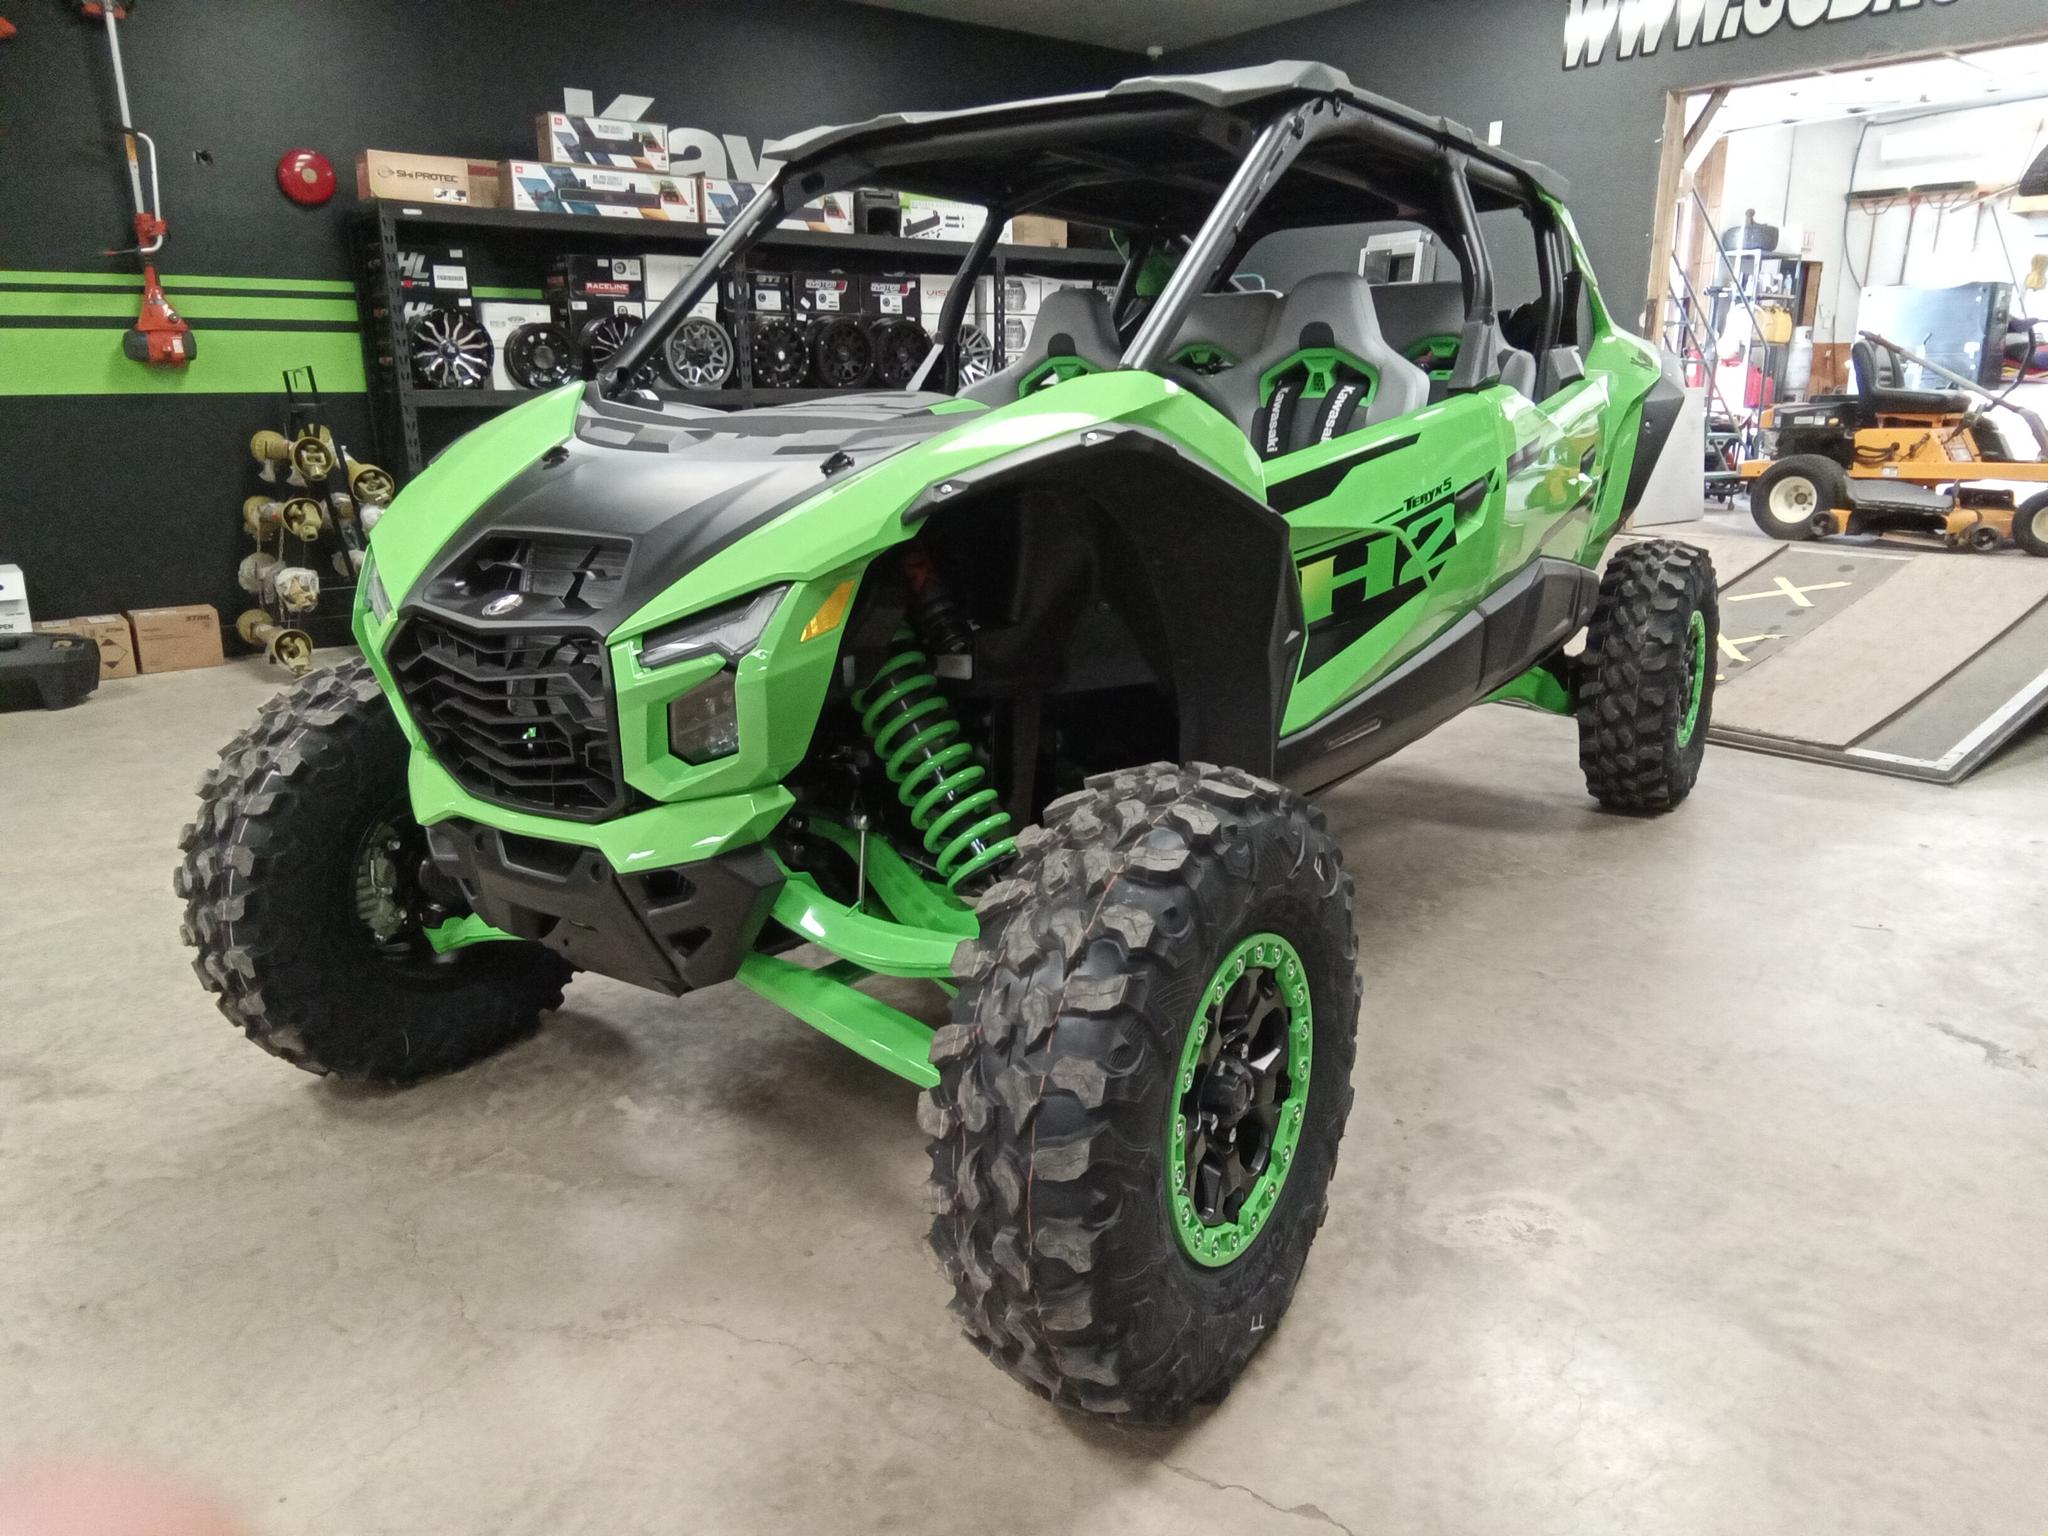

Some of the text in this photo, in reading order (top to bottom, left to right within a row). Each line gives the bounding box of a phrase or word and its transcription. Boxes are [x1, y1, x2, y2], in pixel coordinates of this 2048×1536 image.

[586, 282, 630, 291] RACELINE
[926, 289, 950, 297] VIS
[1299, 502, 1456, 625] H2
